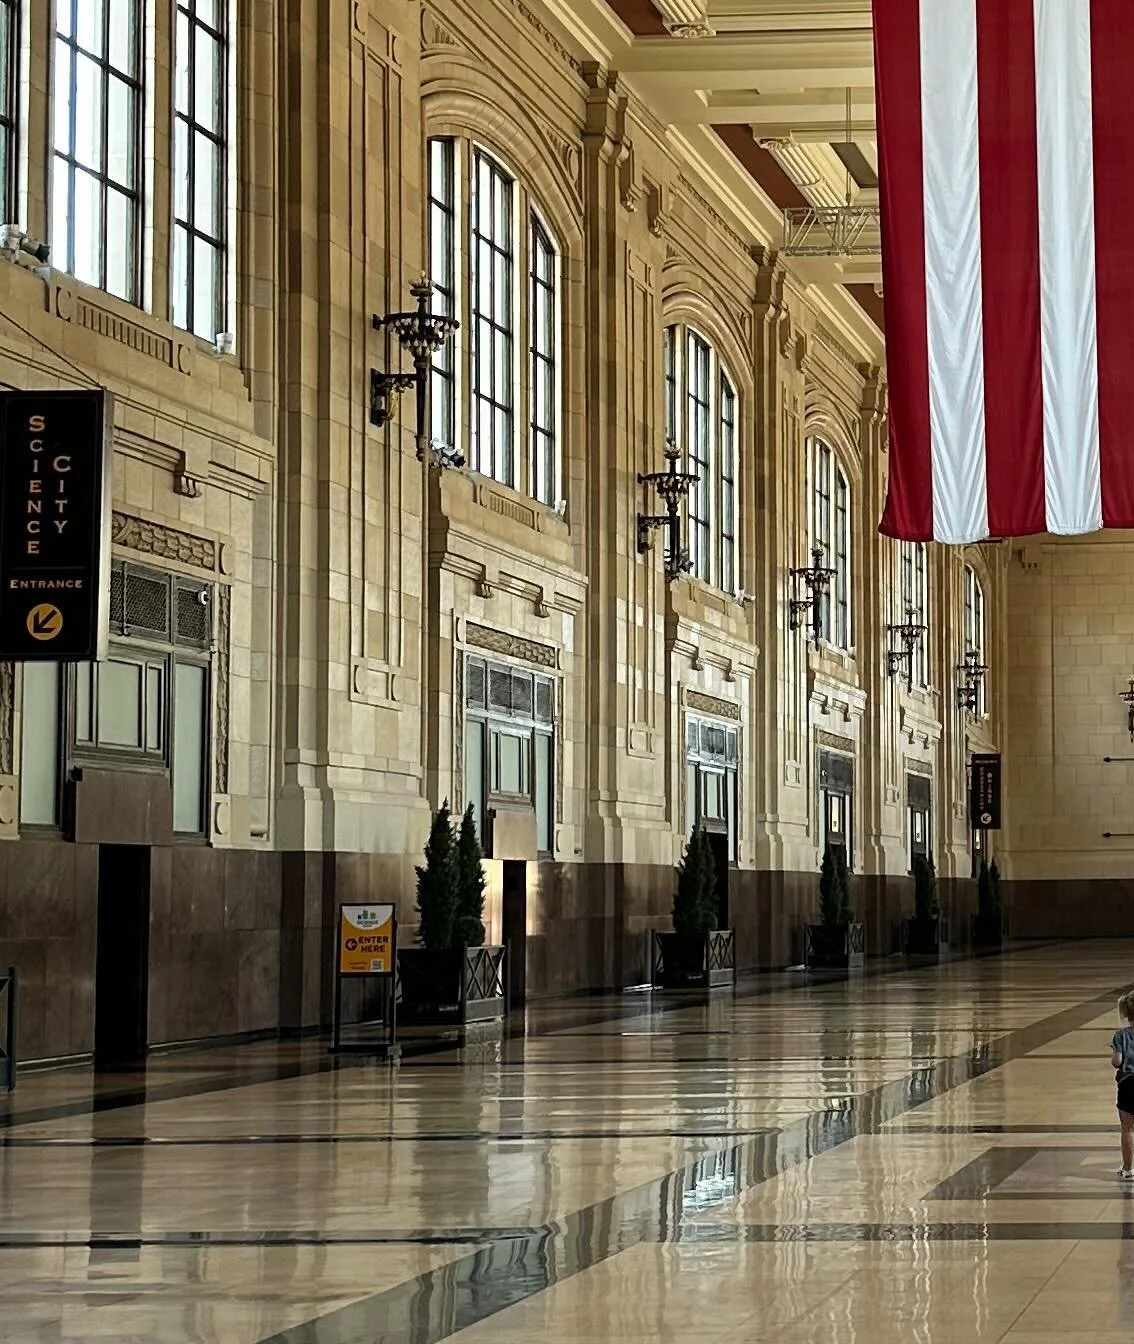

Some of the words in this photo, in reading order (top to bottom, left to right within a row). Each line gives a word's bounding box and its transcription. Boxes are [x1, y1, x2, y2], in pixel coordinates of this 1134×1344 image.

[26, 415, 46, 555] SCIENCE
[53, 456, 72, 534] CITY
[10, 578, 83, 589] ENTRANCE
[358, 936, 389, 944] ENTER
